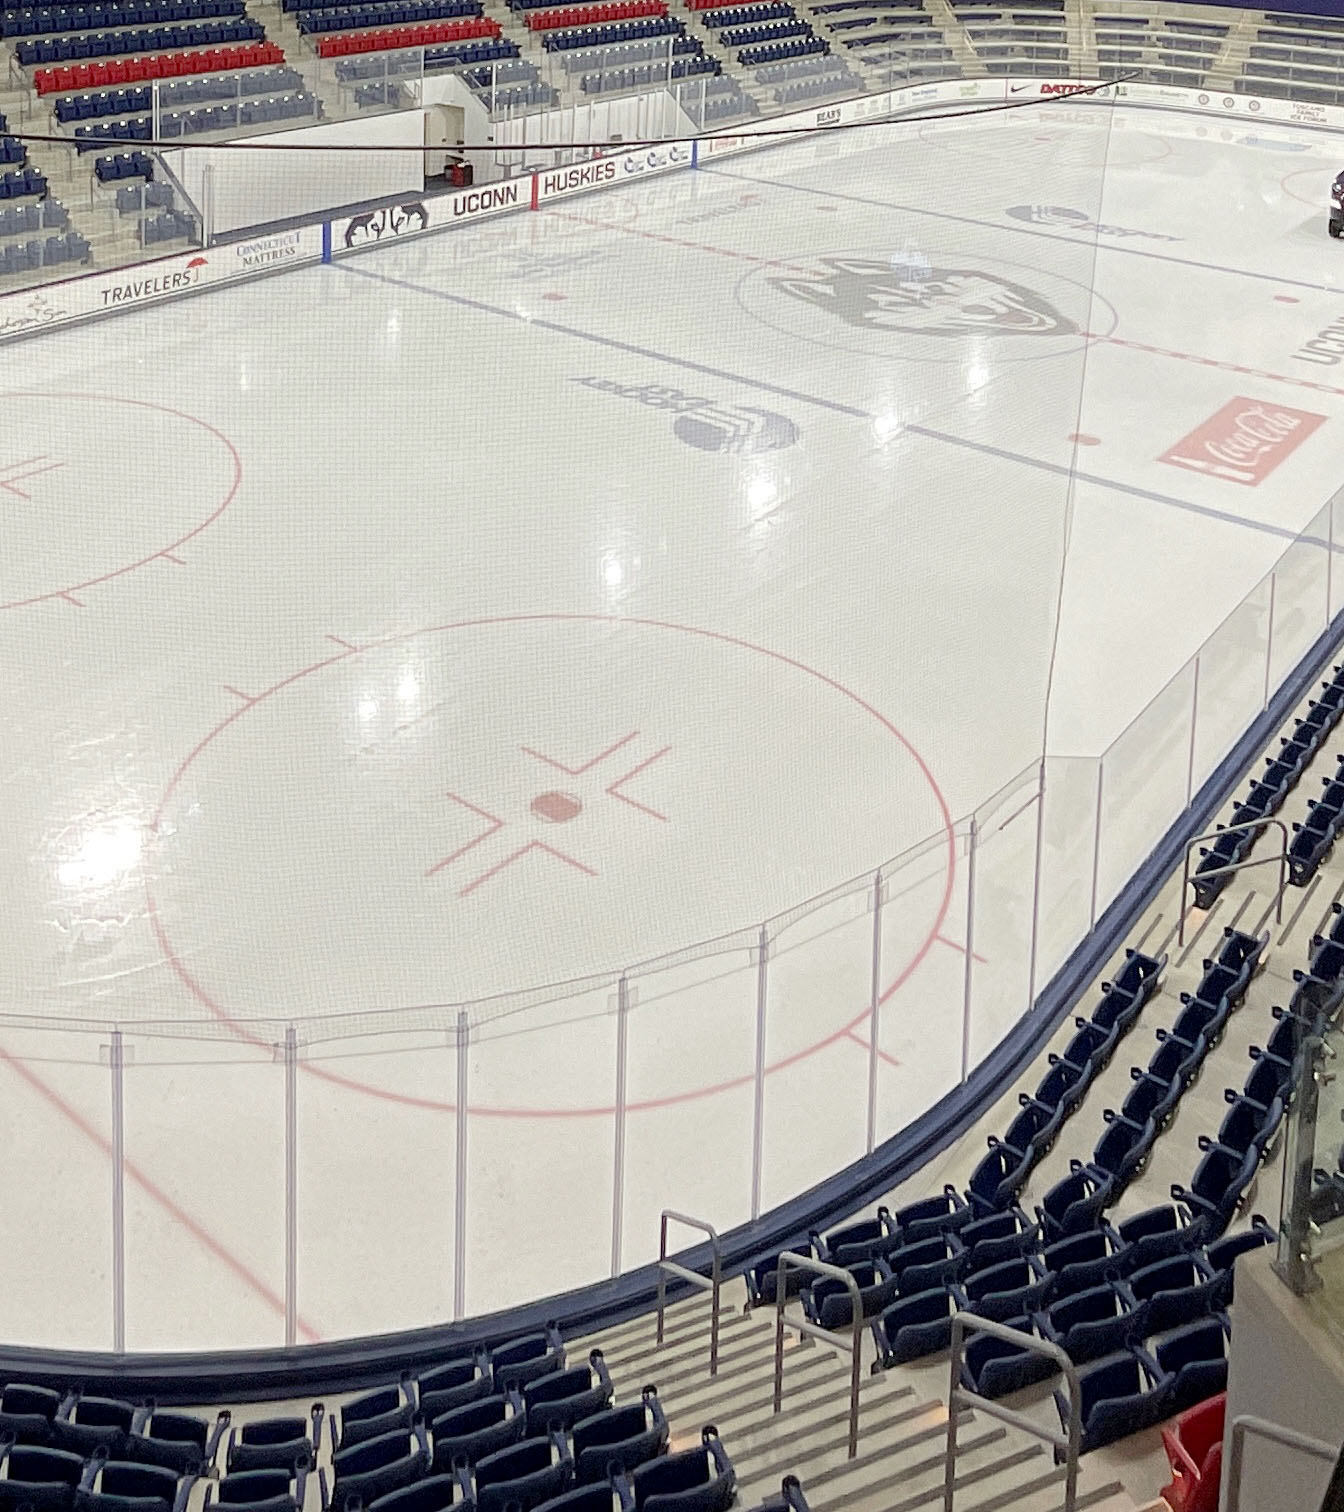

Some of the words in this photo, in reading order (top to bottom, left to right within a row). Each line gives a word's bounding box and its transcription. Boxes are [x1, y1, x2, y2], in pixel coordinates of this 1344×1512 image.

[544, 161, 616, 195] HUSKIES
[453, 184, 518, 216] UCONN
[236, 231, 302, 257] CONNECTICUT
[243, 246, 296, 267] MATTRESS
[101, 270, 191, 305] TRAVELERS
